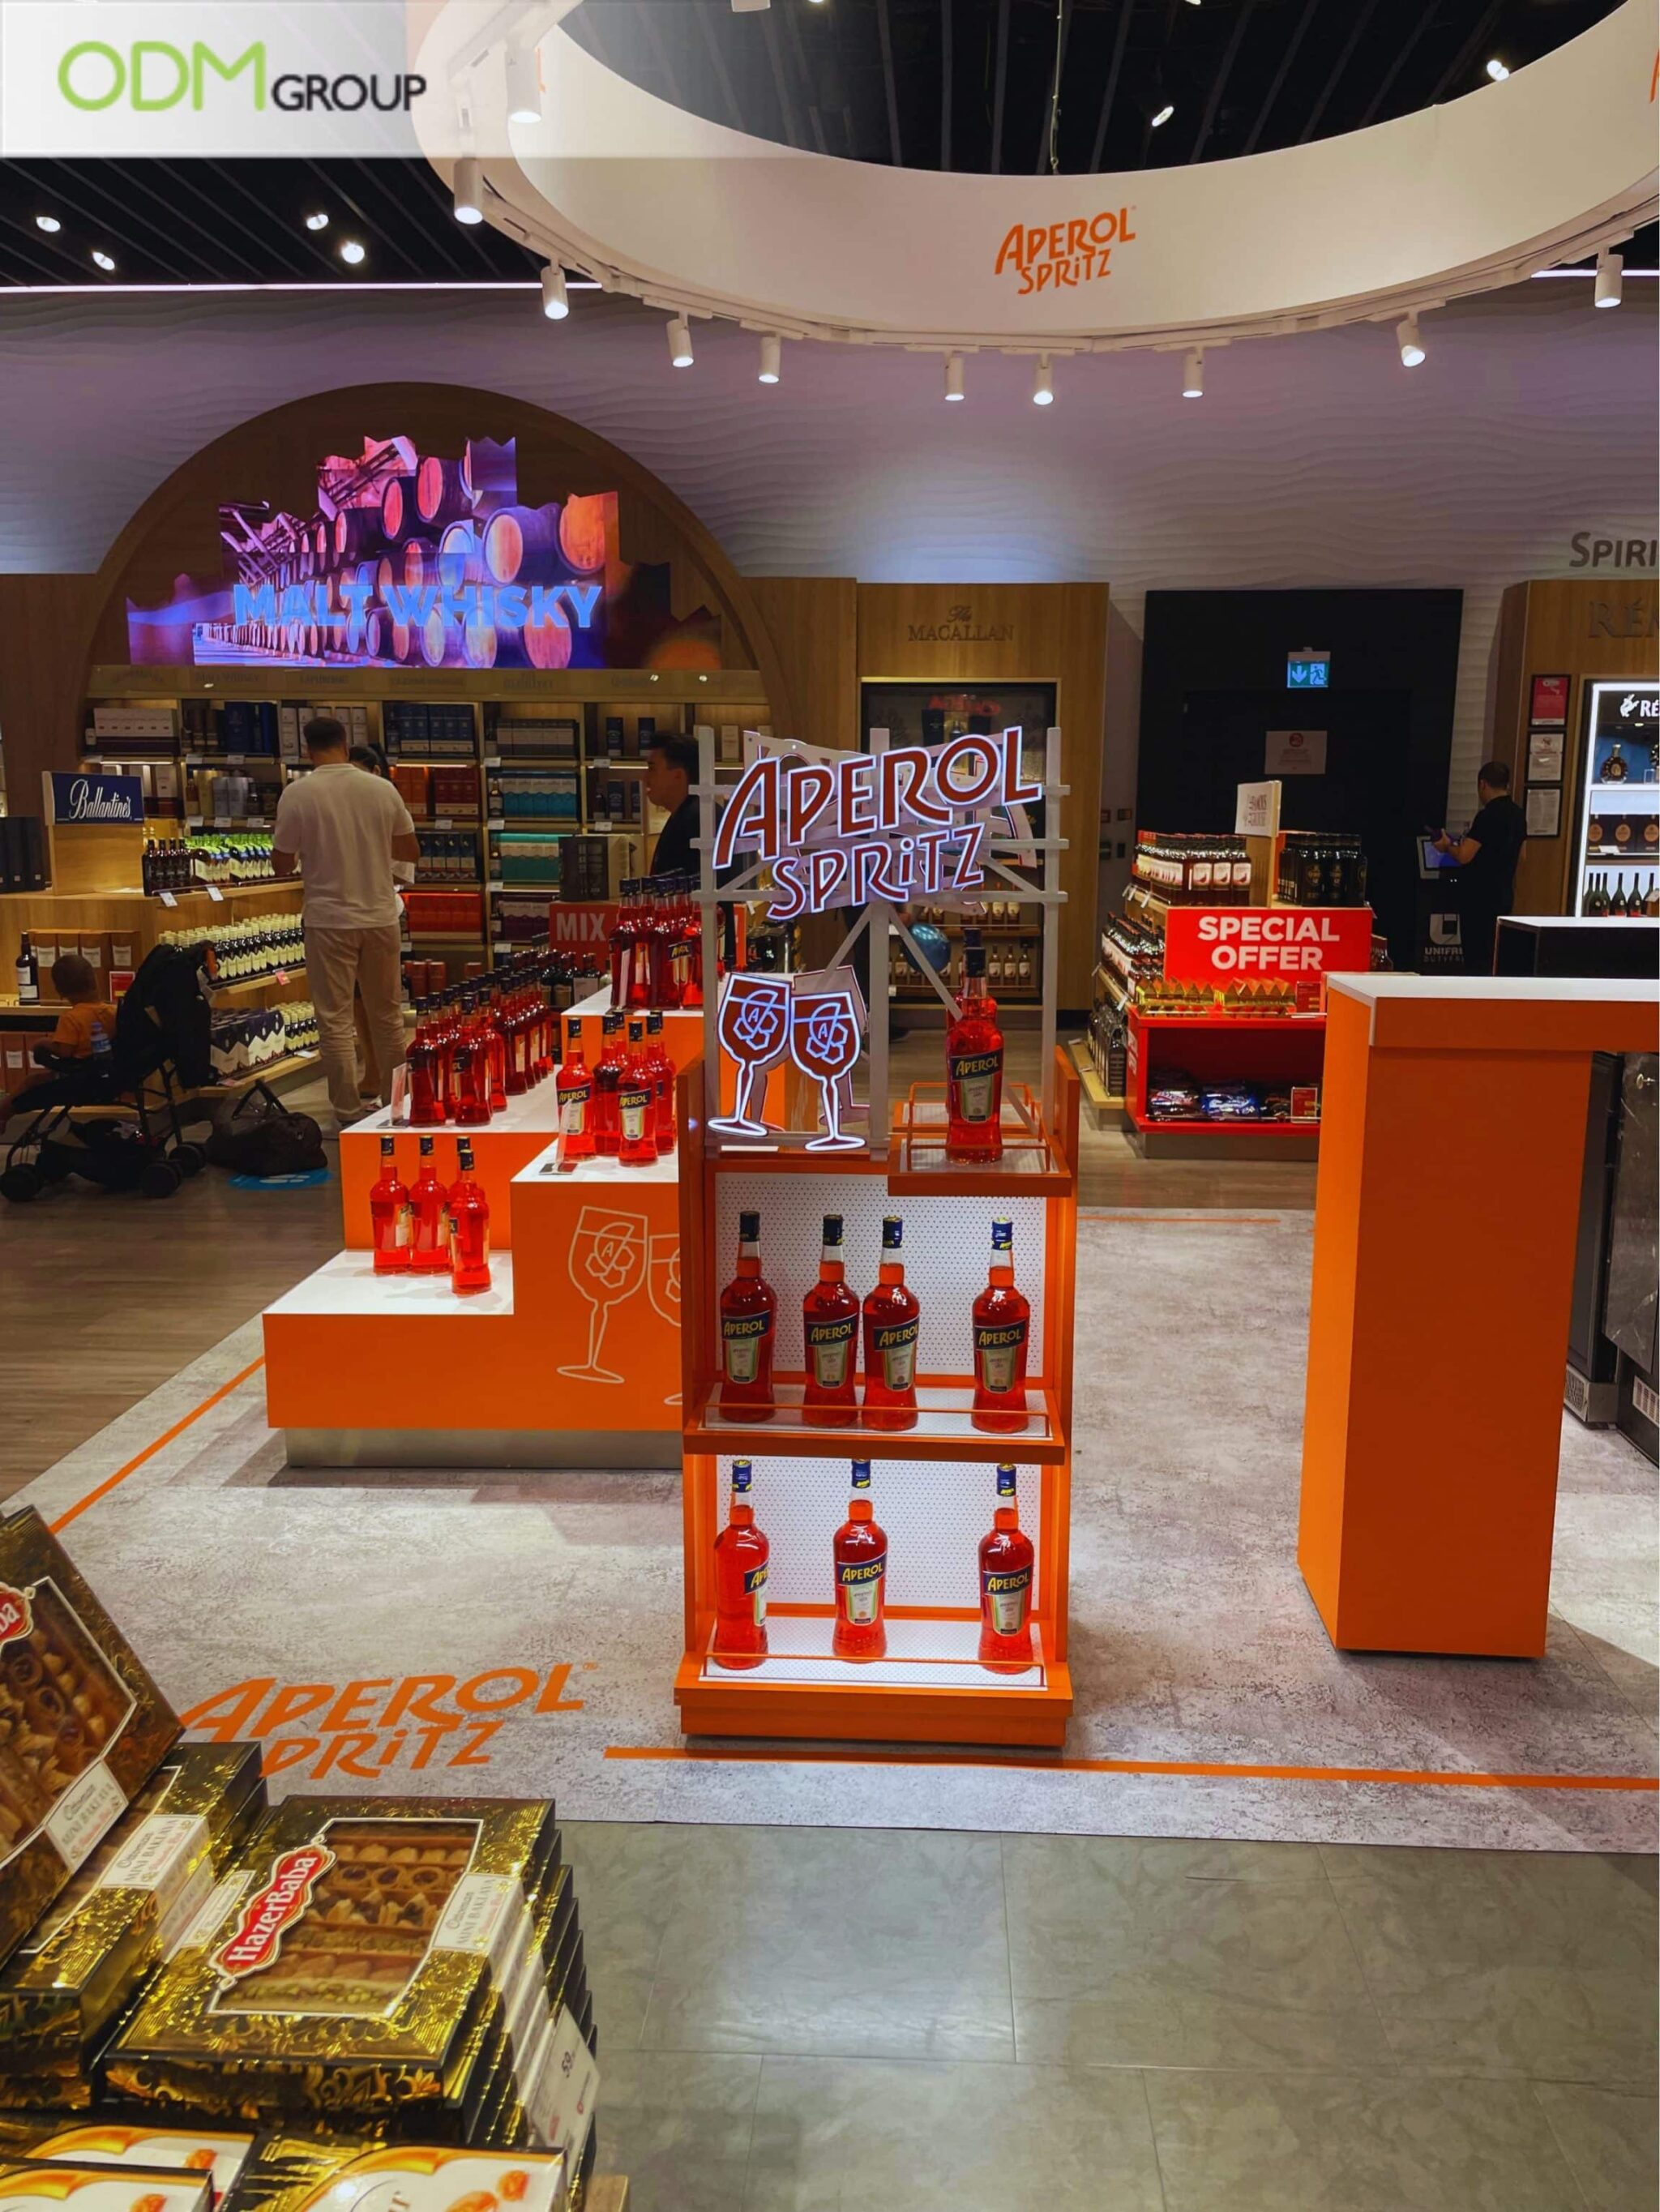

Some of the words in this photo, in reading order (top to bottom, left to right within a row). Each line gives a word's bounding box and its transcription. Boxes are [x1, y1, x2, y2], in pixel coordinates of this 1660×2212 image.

[995, 208, 1136, 275] APEROL
[233, 584, 372, 627] MALT
[381, 584, 602, 628] WHISKY
[909, 625, 1014, 642] MACALLAN
[69, 778, 132, 819] Ballantine's
[712, 726, 1042, 870] APEROL
[556, 913, 606, 941] MIX
[1197, 916, 1340, 942] SPECIAL
[1212, 945, 1323, 970] OFFER
[956, 1057, 999, 1075] APEROL
[724, 1320, 764, 1336] APEROL
[811, 1324, 853, 1342] APEROL
[978, 1328, 1021, 1346] APEROL
[841, 1563, 883, 1582] APEROL
[987, 1572, 1029, 1591] APEROL
[180, 1662, 584, 1744] APEROL
[228, 1854, 318, 1965] HazerBaba
